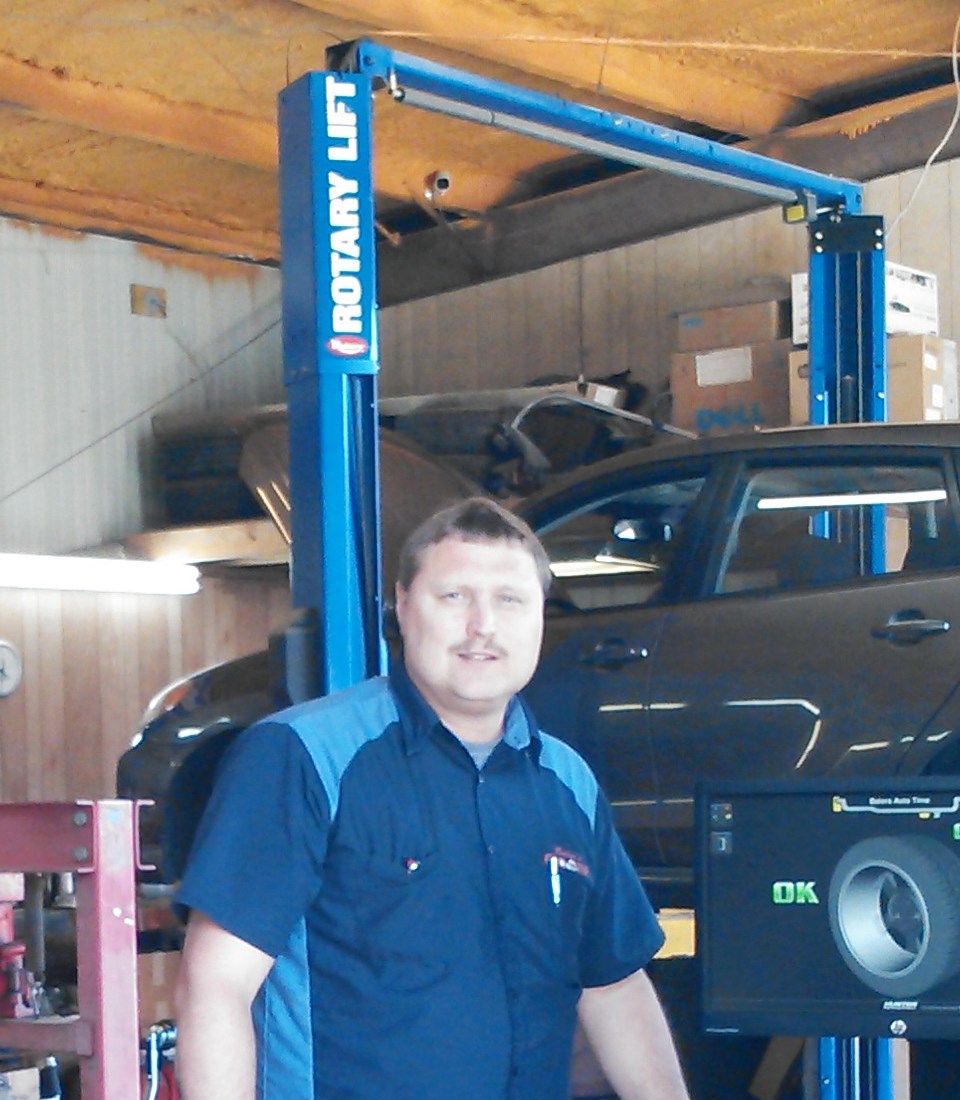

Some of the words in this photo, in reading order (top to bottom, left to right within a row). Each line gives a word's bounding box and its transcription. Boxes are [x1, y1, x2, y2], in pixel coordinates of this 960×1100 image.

[326, 75, 358, 161] LIFT
[328, 171, 363, 334] ROTARY
[772, 881, 819, 904] OK
